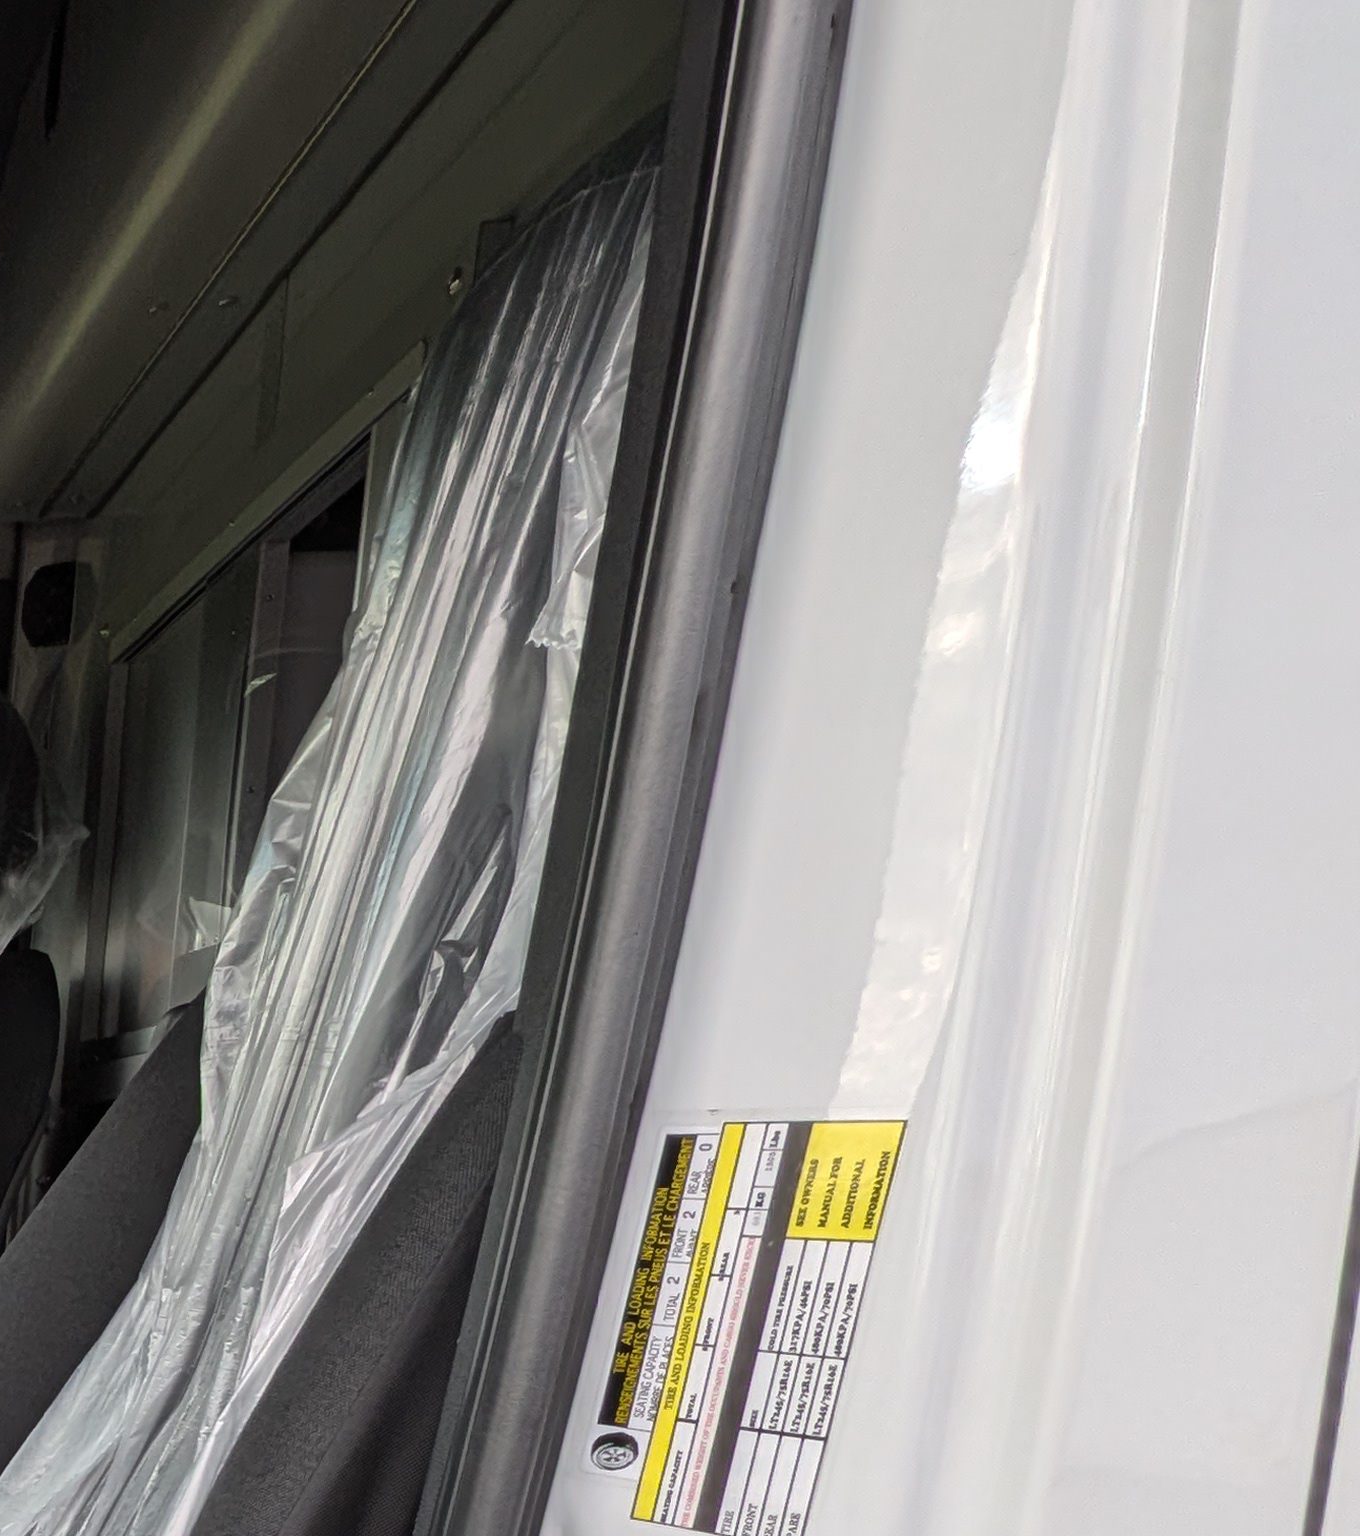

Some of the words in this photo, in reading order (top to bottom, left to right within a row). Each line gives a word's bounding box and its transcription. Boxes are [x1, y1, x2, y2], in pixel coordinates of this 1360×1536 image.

[769, 1130, 781, 1147] Lbs
[666, 1138, 693, 1211] CHARGEMENT
[686, 1170, 701, 1193] REAR
[698, 1142, 712, 1151] 0
[800, 1158, 819, 1204] OWNERS
[754, 1192, 765, 1207] KG
[817, 1181, 836, 1227] MANUAL
[829, 1156, 842, 1177] FOR
[840, 1159, 864, 1228] ADDITIONAL
[863, 1151, 890, 1229] INFORMATION
[641, 1187, 668, 1258] INFORMATION
[662, 1215, 675, 1227] LE
[795, 1207, 807, 1226] SEE
[658, 1231, 671, 1244] ET
[671, 1227, 687, 1257] FRONT
[682, 1210, 696, 1219] 2
[649, 1247, 667, 1282] PNEUS
[686, 1242, 709, 1313] INFORMATION
[627, 1267, 649, 1315] LOADING
[643, 1285, 658, 1304] LES
[666, 1275, 680, 1285] 2
[777, 1265, 793, 1306] PRESSURE
[637, 1309, 653, 1327] SUR
[663, 1293, 680, 1320] TOTAL
[772, 1308, 783, 1327] TIRE
[620, 1321, 635, 1345] AND
[674, 1315, 693, 1361] LOADING
[767, 1328, 777, 1350] COLD
[612, 1351, 629, 1372] TIRE
[633, 1381, 651, 1415] SEATING
[642, 1336, 661, 1379] CAPACITY
[670, 1363, 682, 1385] AND
[614, 1334, 647, 1423] RENSEIGNEMENTS
[663, 1386, 677, 1409] TIRE
[685, 1393, 697, 1418] TOTAL
[659, 1489, 673, 1522] SEATING
[668, 1449, 683, 1488] CAPACITY
[720, 1510, 734, 1534] TIRE
[741, 1502, 757, 1536] FRONT
